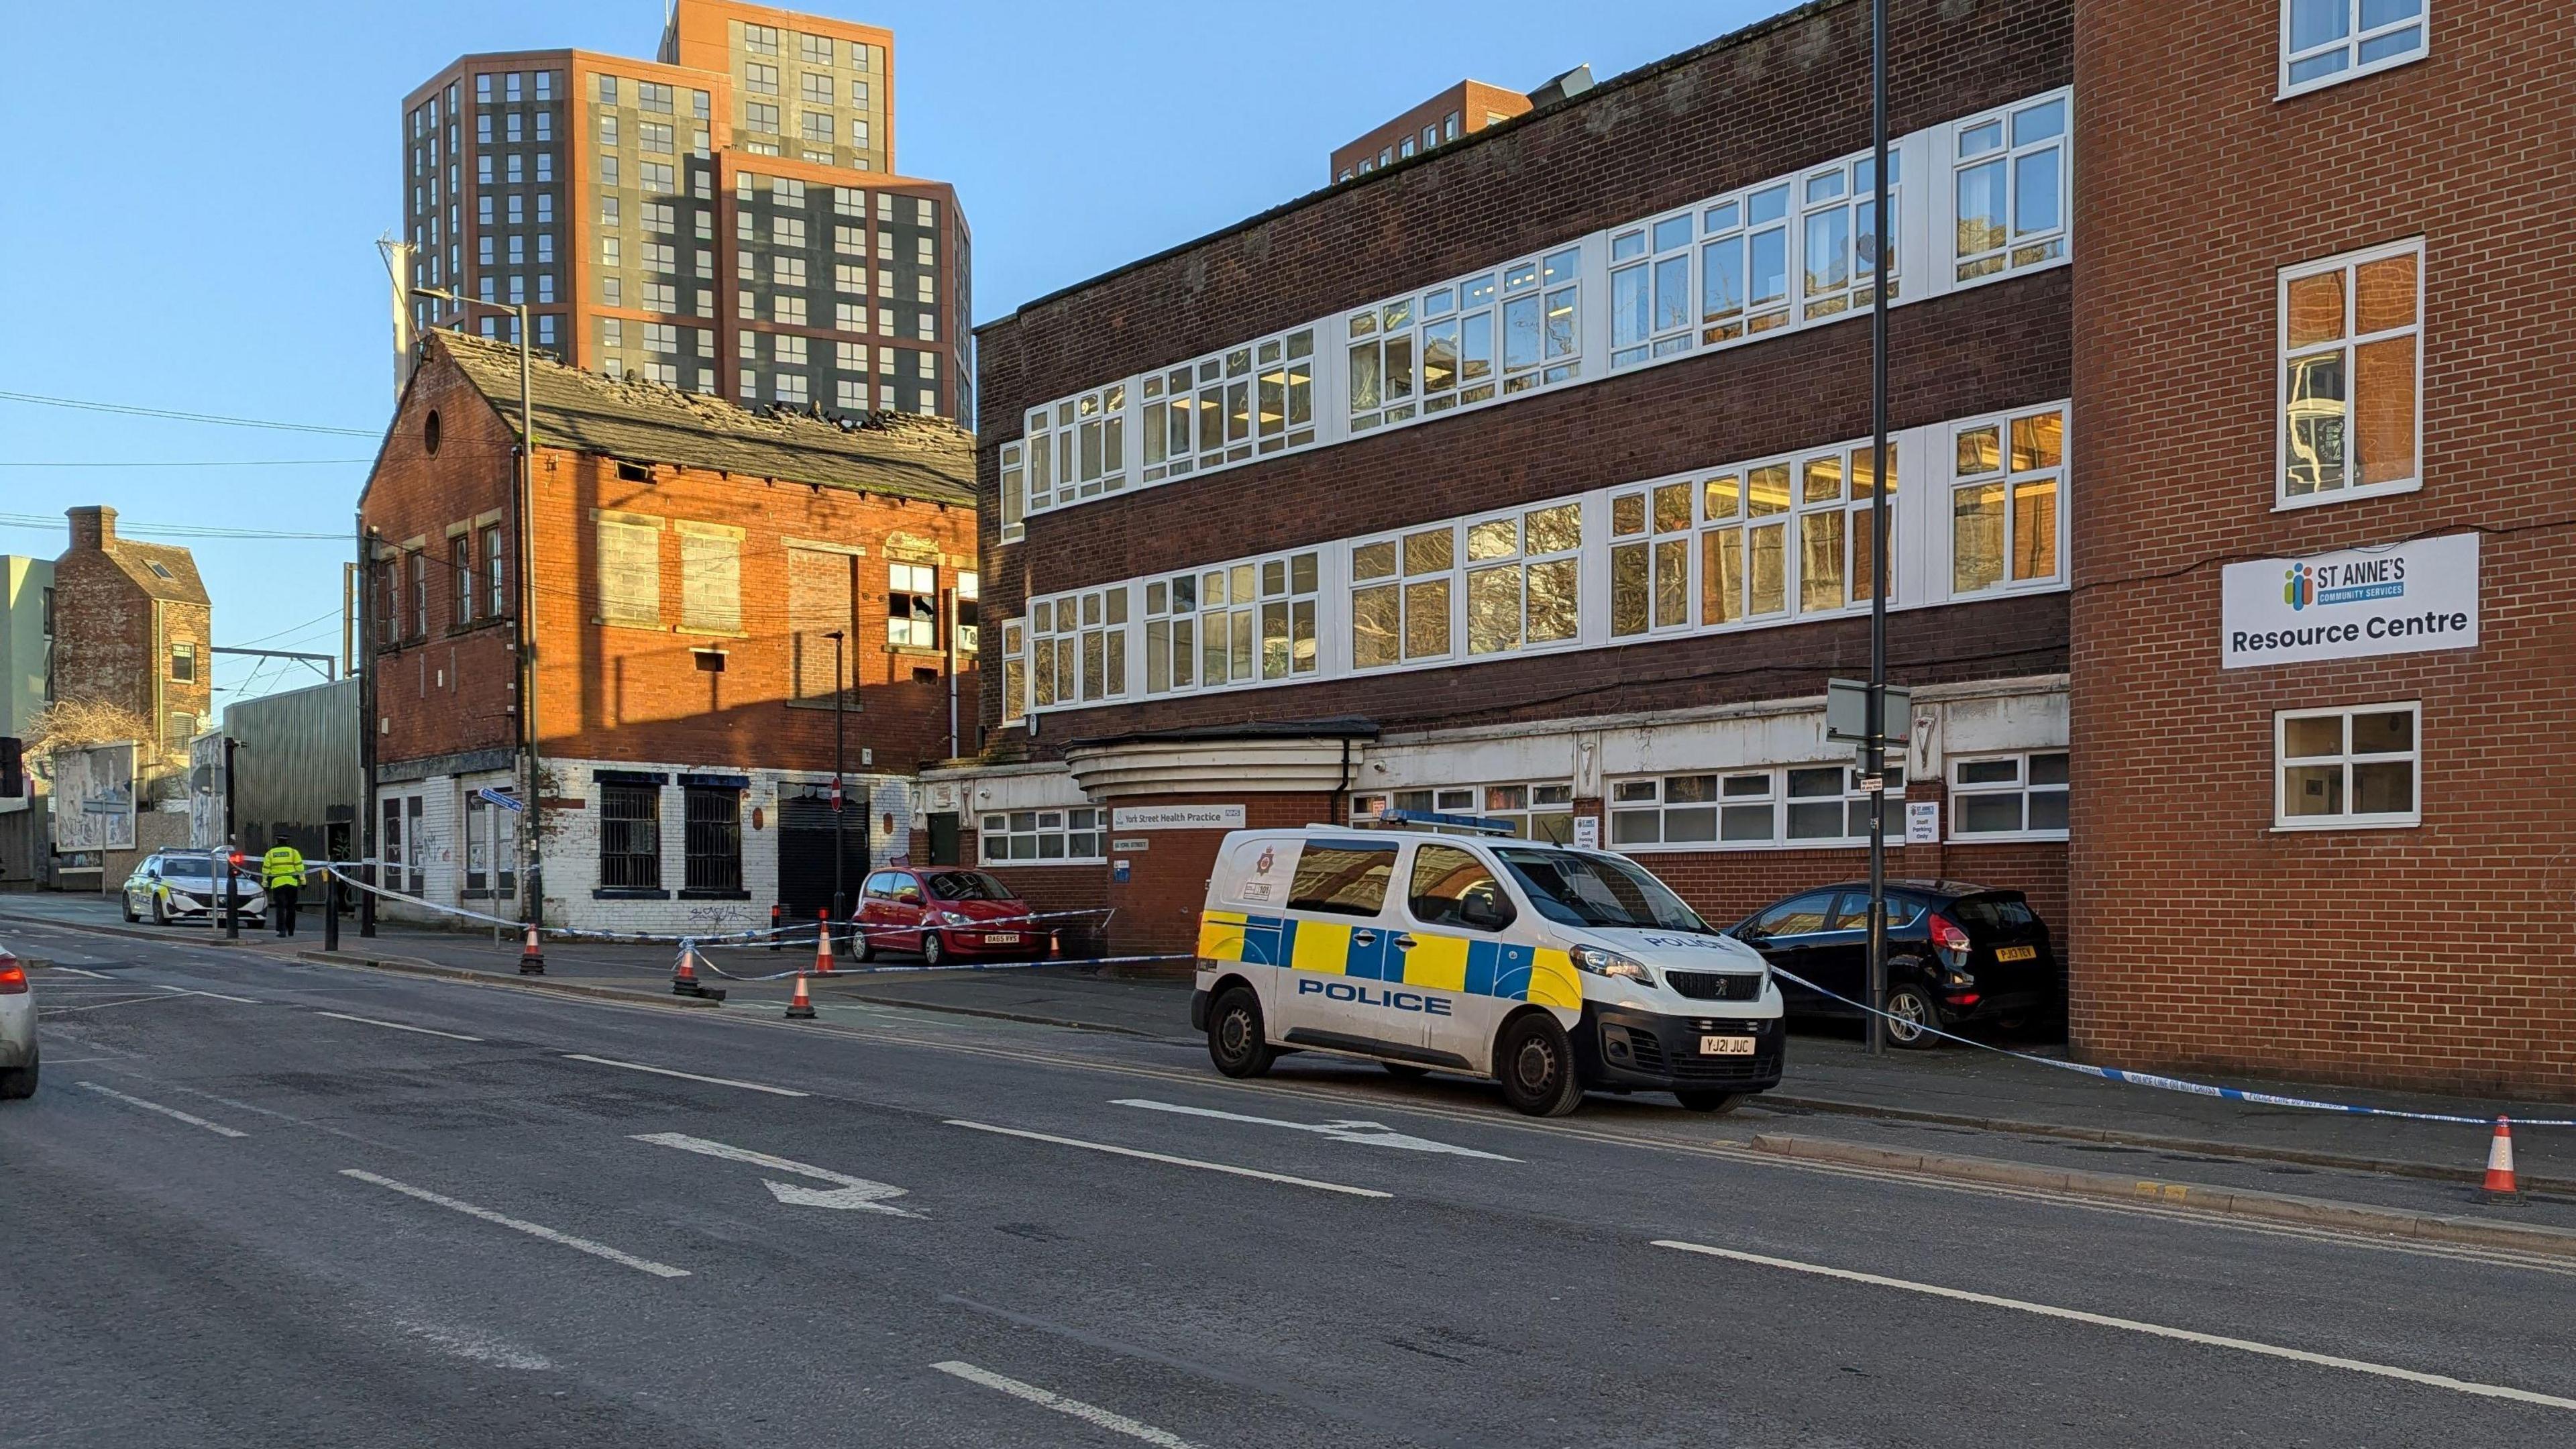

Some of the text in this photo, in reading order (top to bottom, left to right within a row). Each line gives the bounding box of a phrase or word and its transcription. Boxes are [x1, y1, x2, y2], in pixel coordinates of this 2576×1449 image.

[2317, 557, 2405, 588] ST ANNE'S
[2320, 585, 2402, 602] COMMUNITY SERVICES
[2233, 610, 2468, 653] Resource Centre
[1126, 814, 1138, 823] York
[1139, 813, 1159, 823] Street
[1161, 812, 1185, 822] Health
[1187, 812, 1221, 822] Practice
[1260, 885, 1269, 894] 101
[1644, 938, 1733, 951] POLICE
[1298, 978, 1452, 1016] POLICE
[1707, 1038, 1749, 1053] YJ21 JUC
[2131, 1074, 2153, 1087] POLICE
[2153, 1076, 2168, 1088] LINE
[2180, 1081, 2193, 1092] NOT
[2194, 1084, 2216, 1095] CROSS
